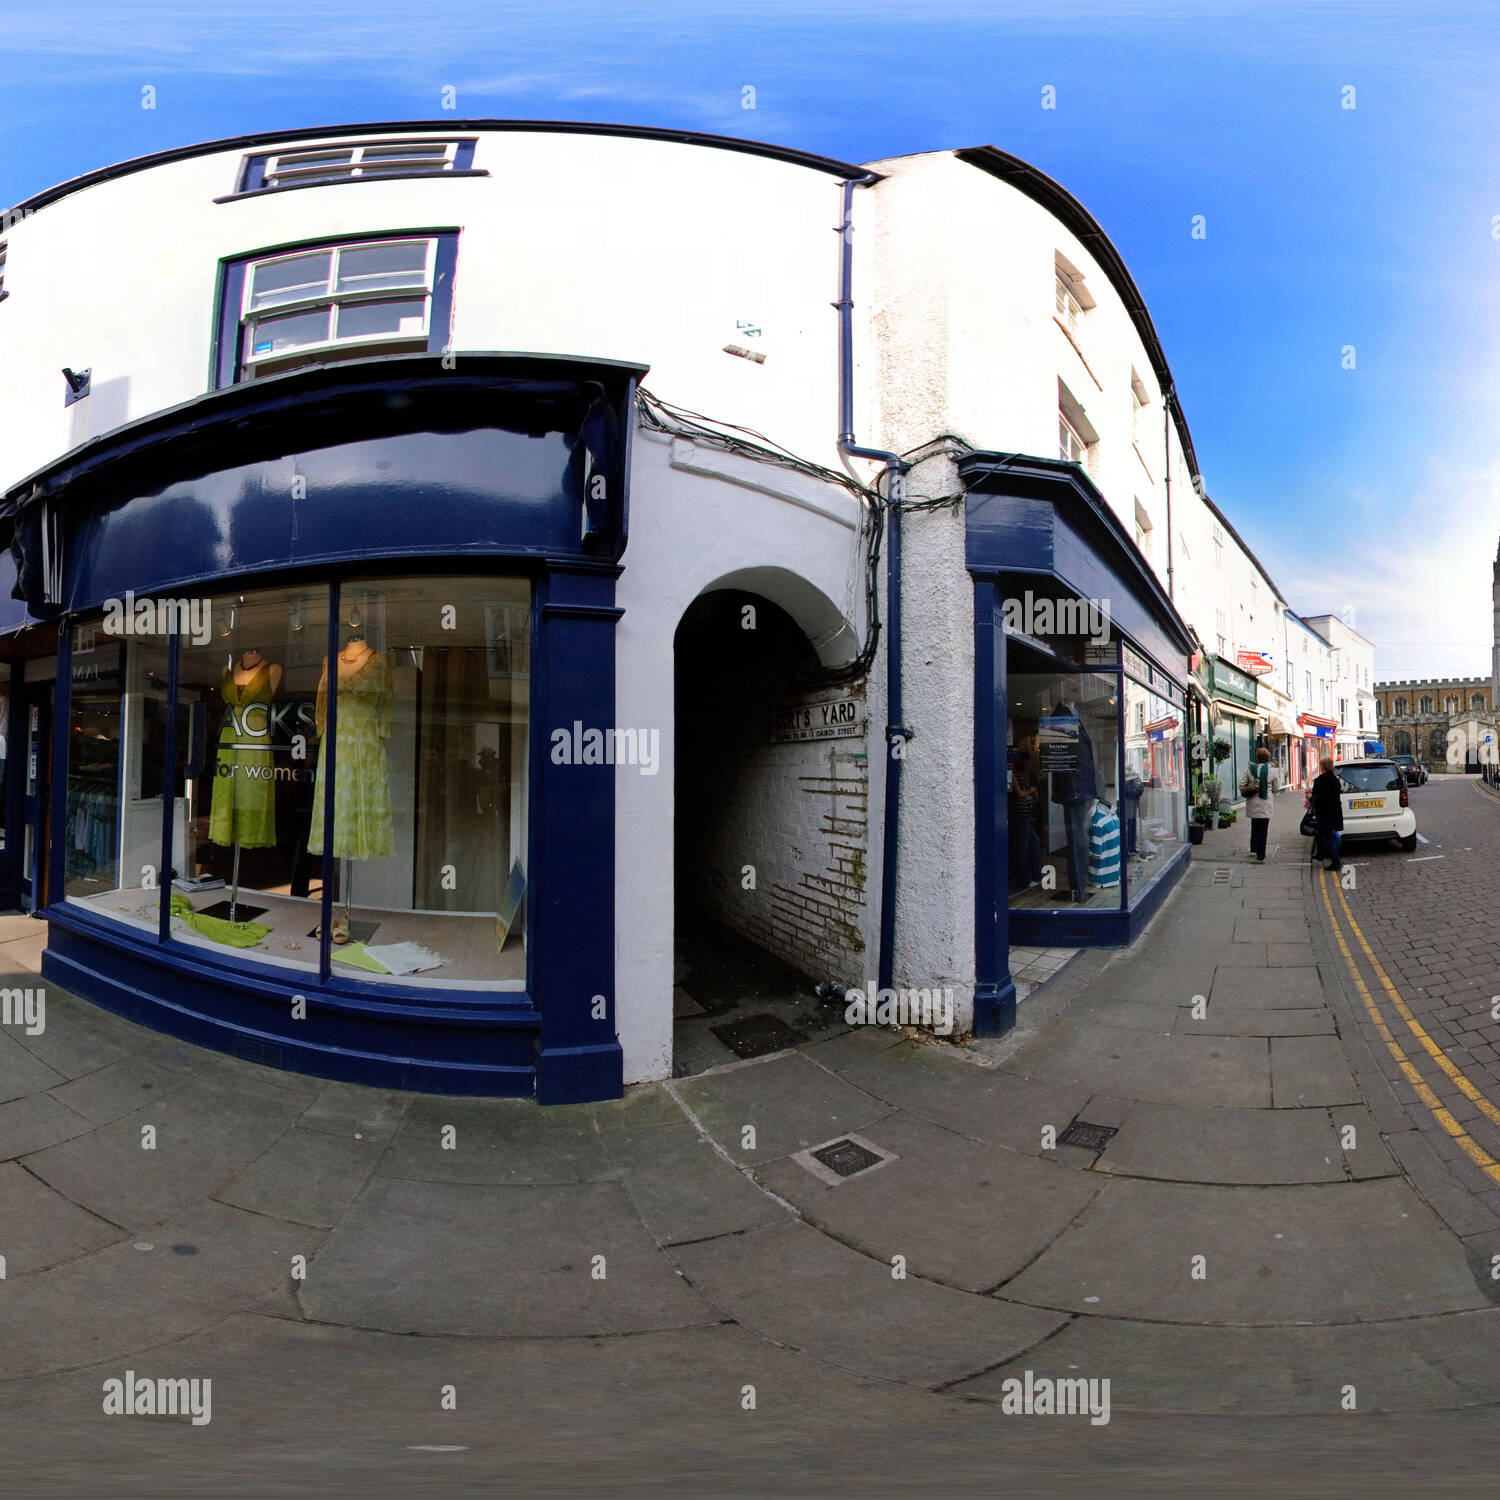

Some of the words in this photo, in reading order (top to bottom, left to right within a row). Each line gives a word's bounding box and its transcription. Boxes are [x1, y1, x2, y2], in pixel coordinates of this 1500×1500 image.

[821, 702, 856, 725] YARD
[816, 728, 835, 737] CHURCH
[837, 727, 856, 735] STREET
[213, 758, 239, 778] for
[245, 764, 315, 783] women
